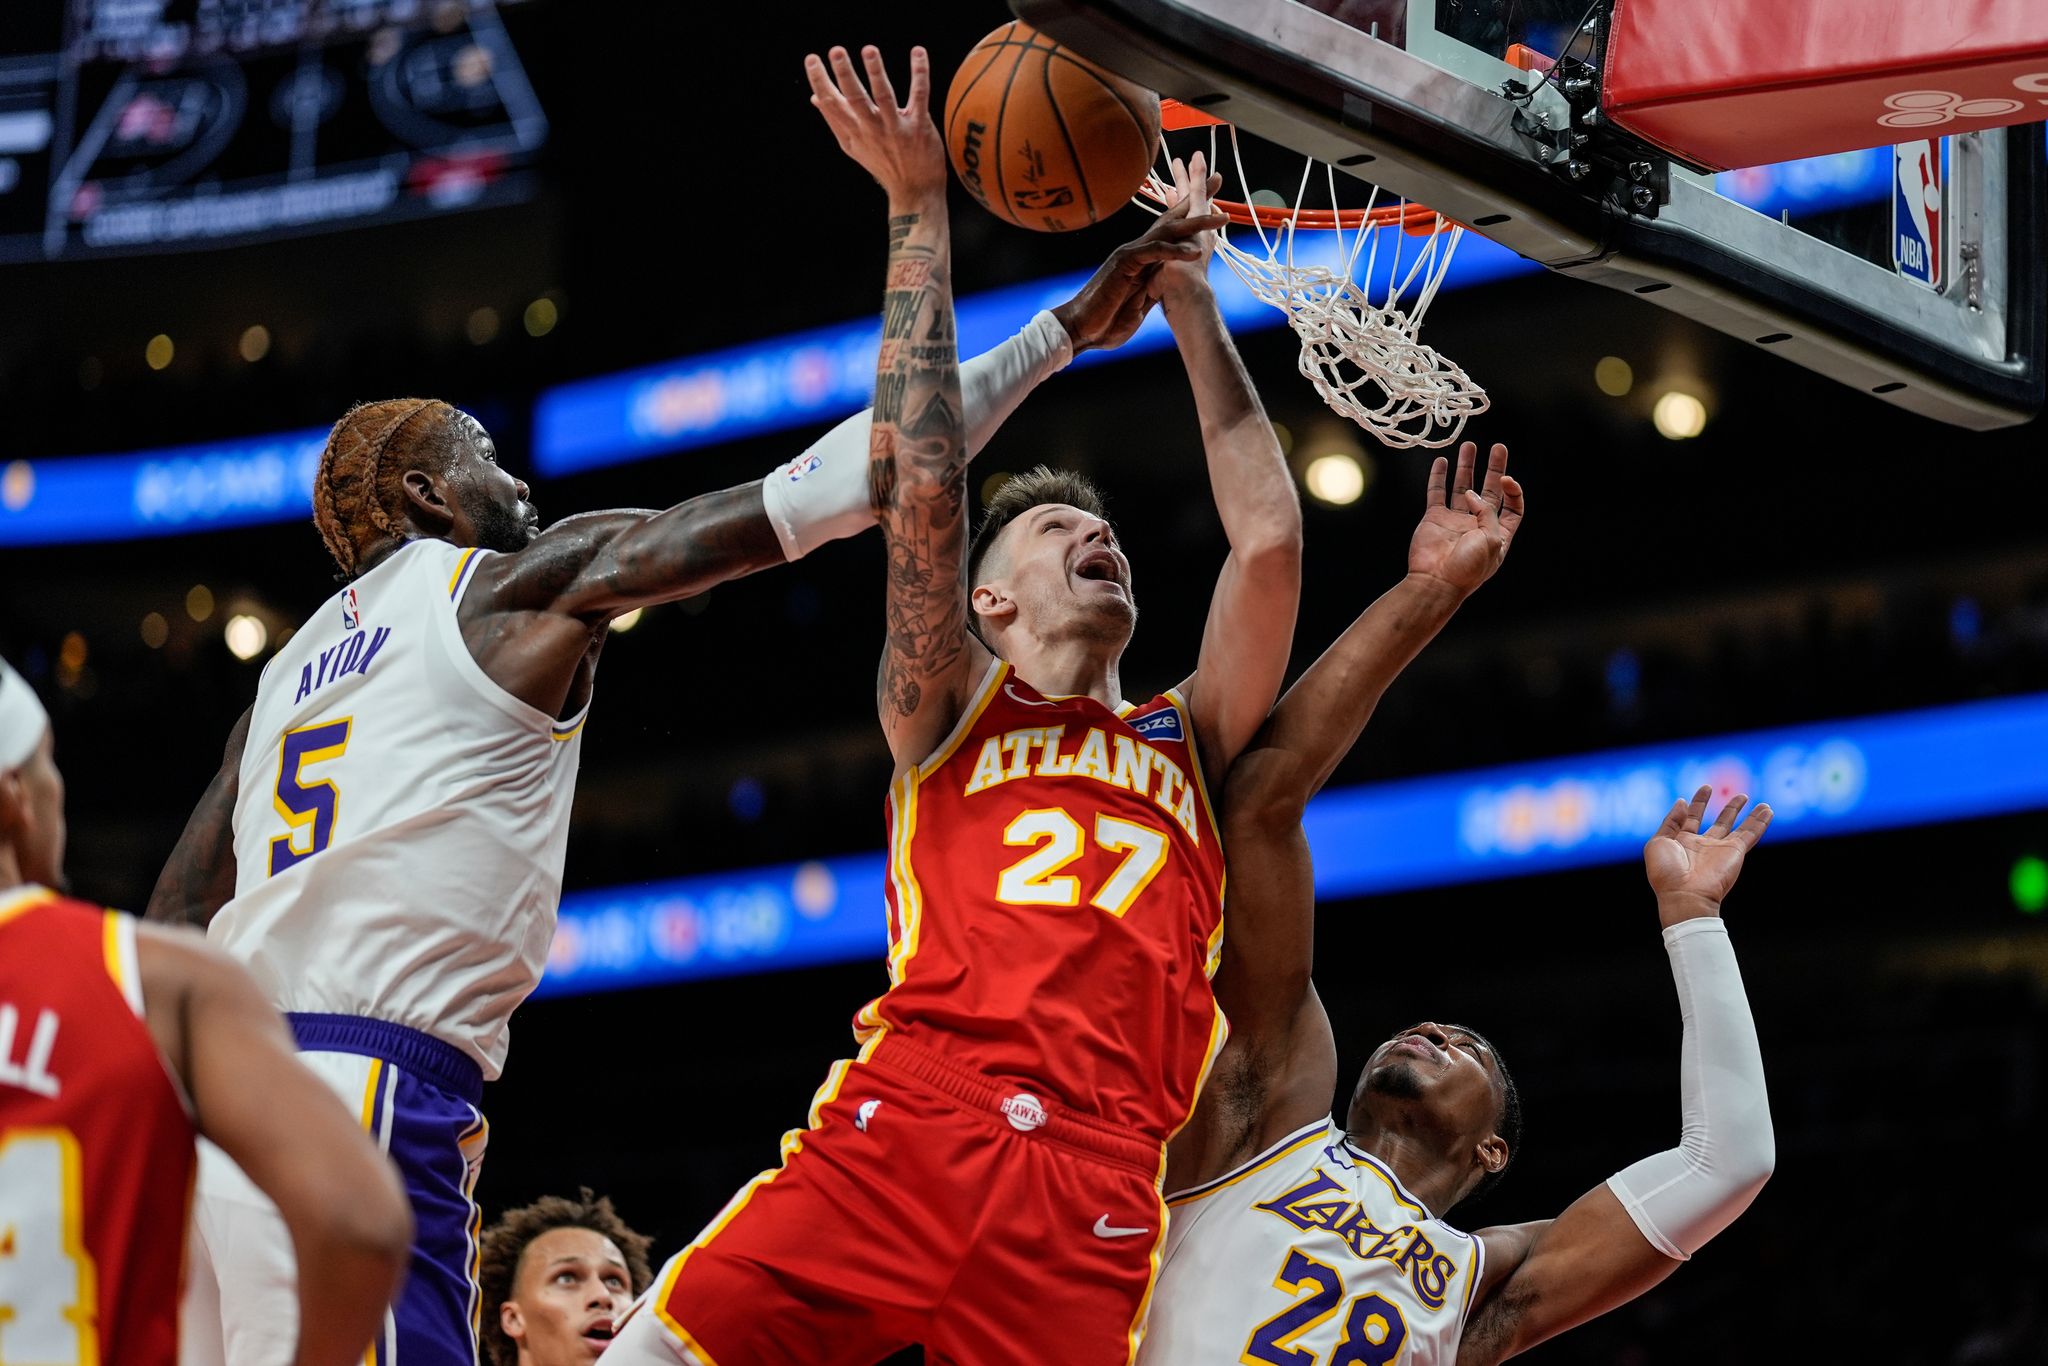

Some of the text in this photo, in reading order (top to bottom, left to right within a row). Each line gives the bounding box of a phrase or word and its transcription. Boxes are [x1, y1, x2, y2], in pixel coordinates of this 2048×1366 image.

[1900, 233, 1924, 272] NBA
[294, 627, 392, 706] AYTON
[268, 715, 353, 879] 5
[964, 723, 1200, 848] ATLANTA
[995, 806, 1171, 919] 27
[1002, 1099, 1048, 1126] HAWKS
[1251, 1168, 1458, 1311] LAKERS
[1239, 1245, 1410, 1366] 28
